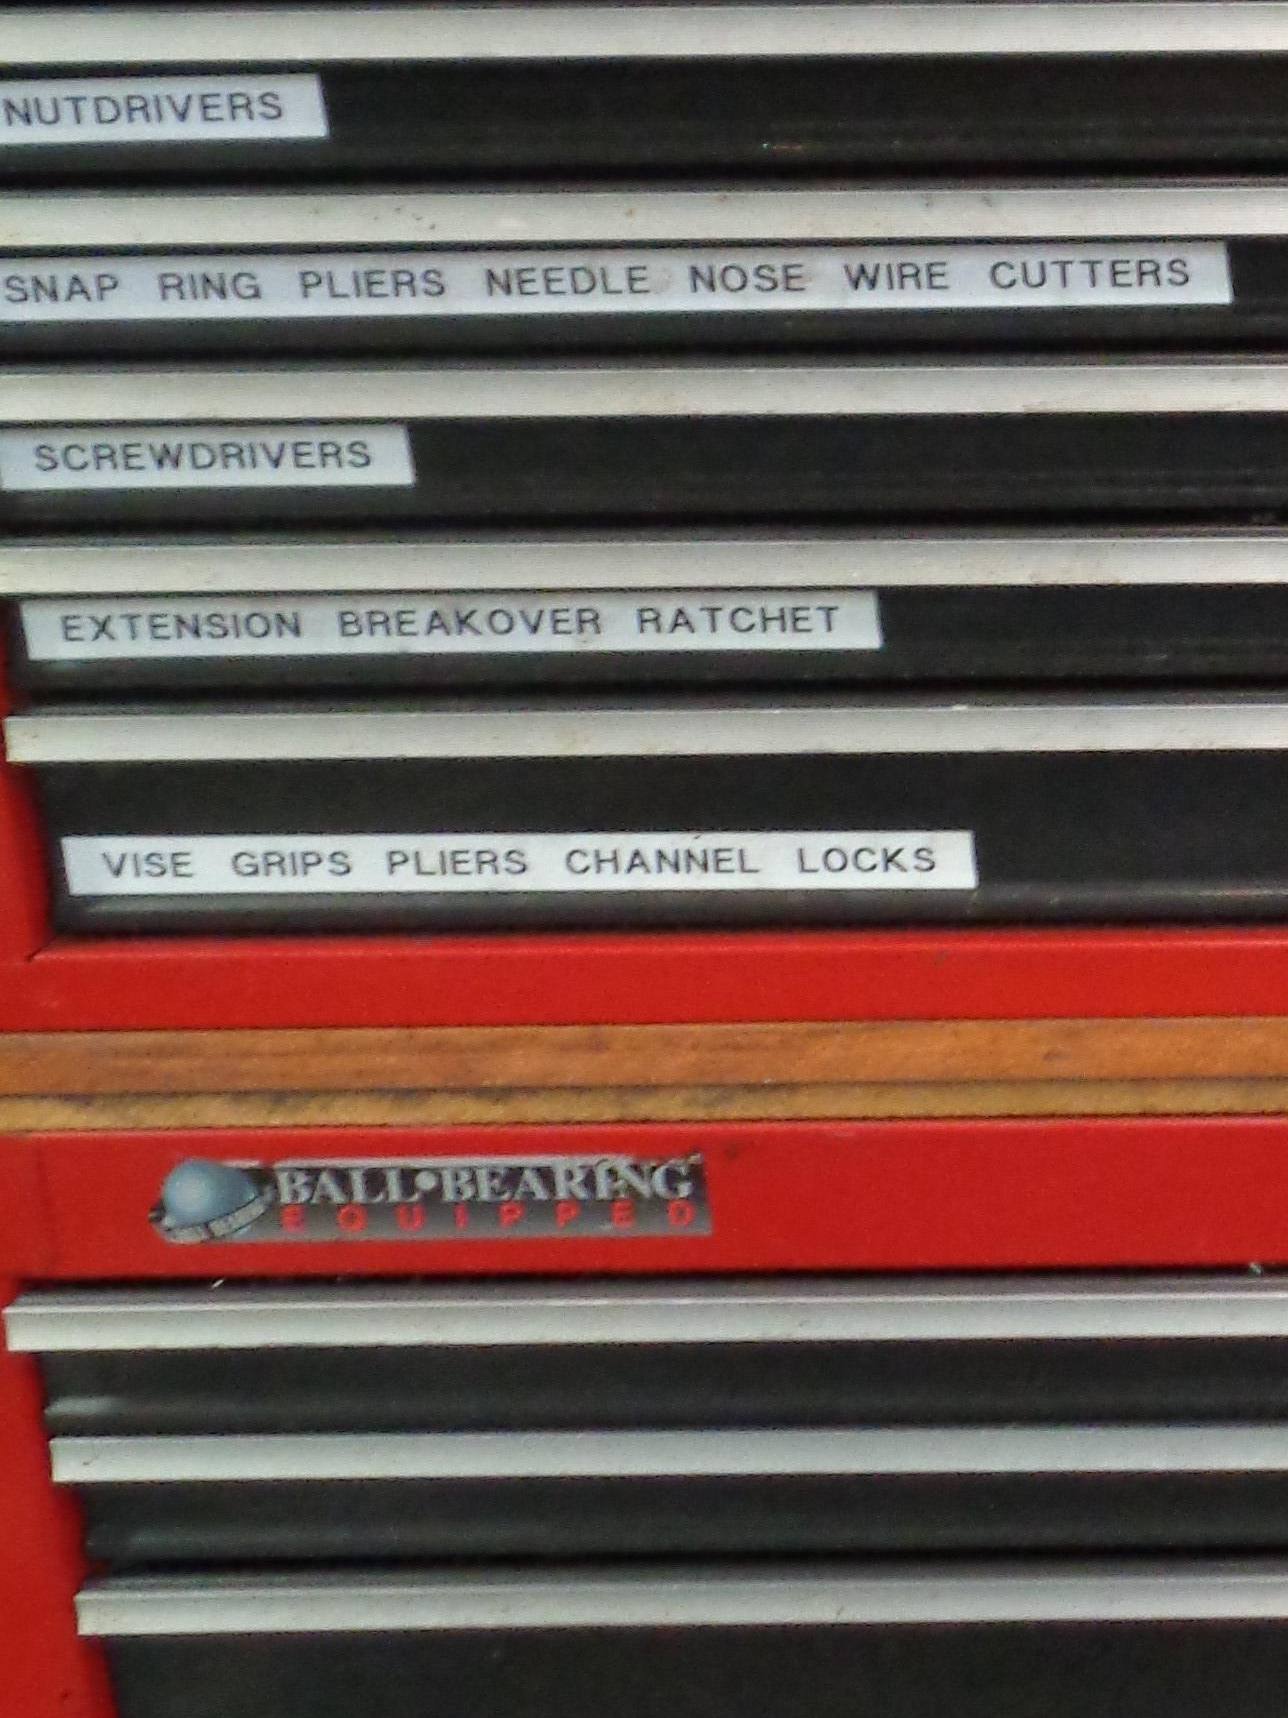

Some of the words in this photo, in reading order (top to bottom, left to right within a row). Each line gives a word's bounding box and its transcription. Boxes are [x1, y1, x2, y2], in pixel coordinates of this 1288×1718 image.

[2, 91, 283, 127] NUTDRIVERS
[4, 273, 119, 303] SNAP
[157, 271, 262, 301] RING
[298, 268, 446, 299] PLIERS
[485, 265, 651, 297] NEEDLE
[689, 263, 806, 293] NOSE
[843, 261, 949, 291] WIRE
[989, 258, 1190, 290] CUTTERS
[35, 440, 372, 472] SCREWDRIVERS
[60, 611, 302, 642] EXTENSION
[337, 606, 602, 637] BREAKOVER
[636, 605, 839, 634] RATCHET
[101, 851, 194, 879] VISE
[231, 850, 352, 877] GRIPS
[386, 849, 529, 876] PLIERS
[565, 847, 760, 875] CHANNEL
[797, 847, 936, 874] LOCKS
[282, 1199, 696, 1232] EQUIPPED
